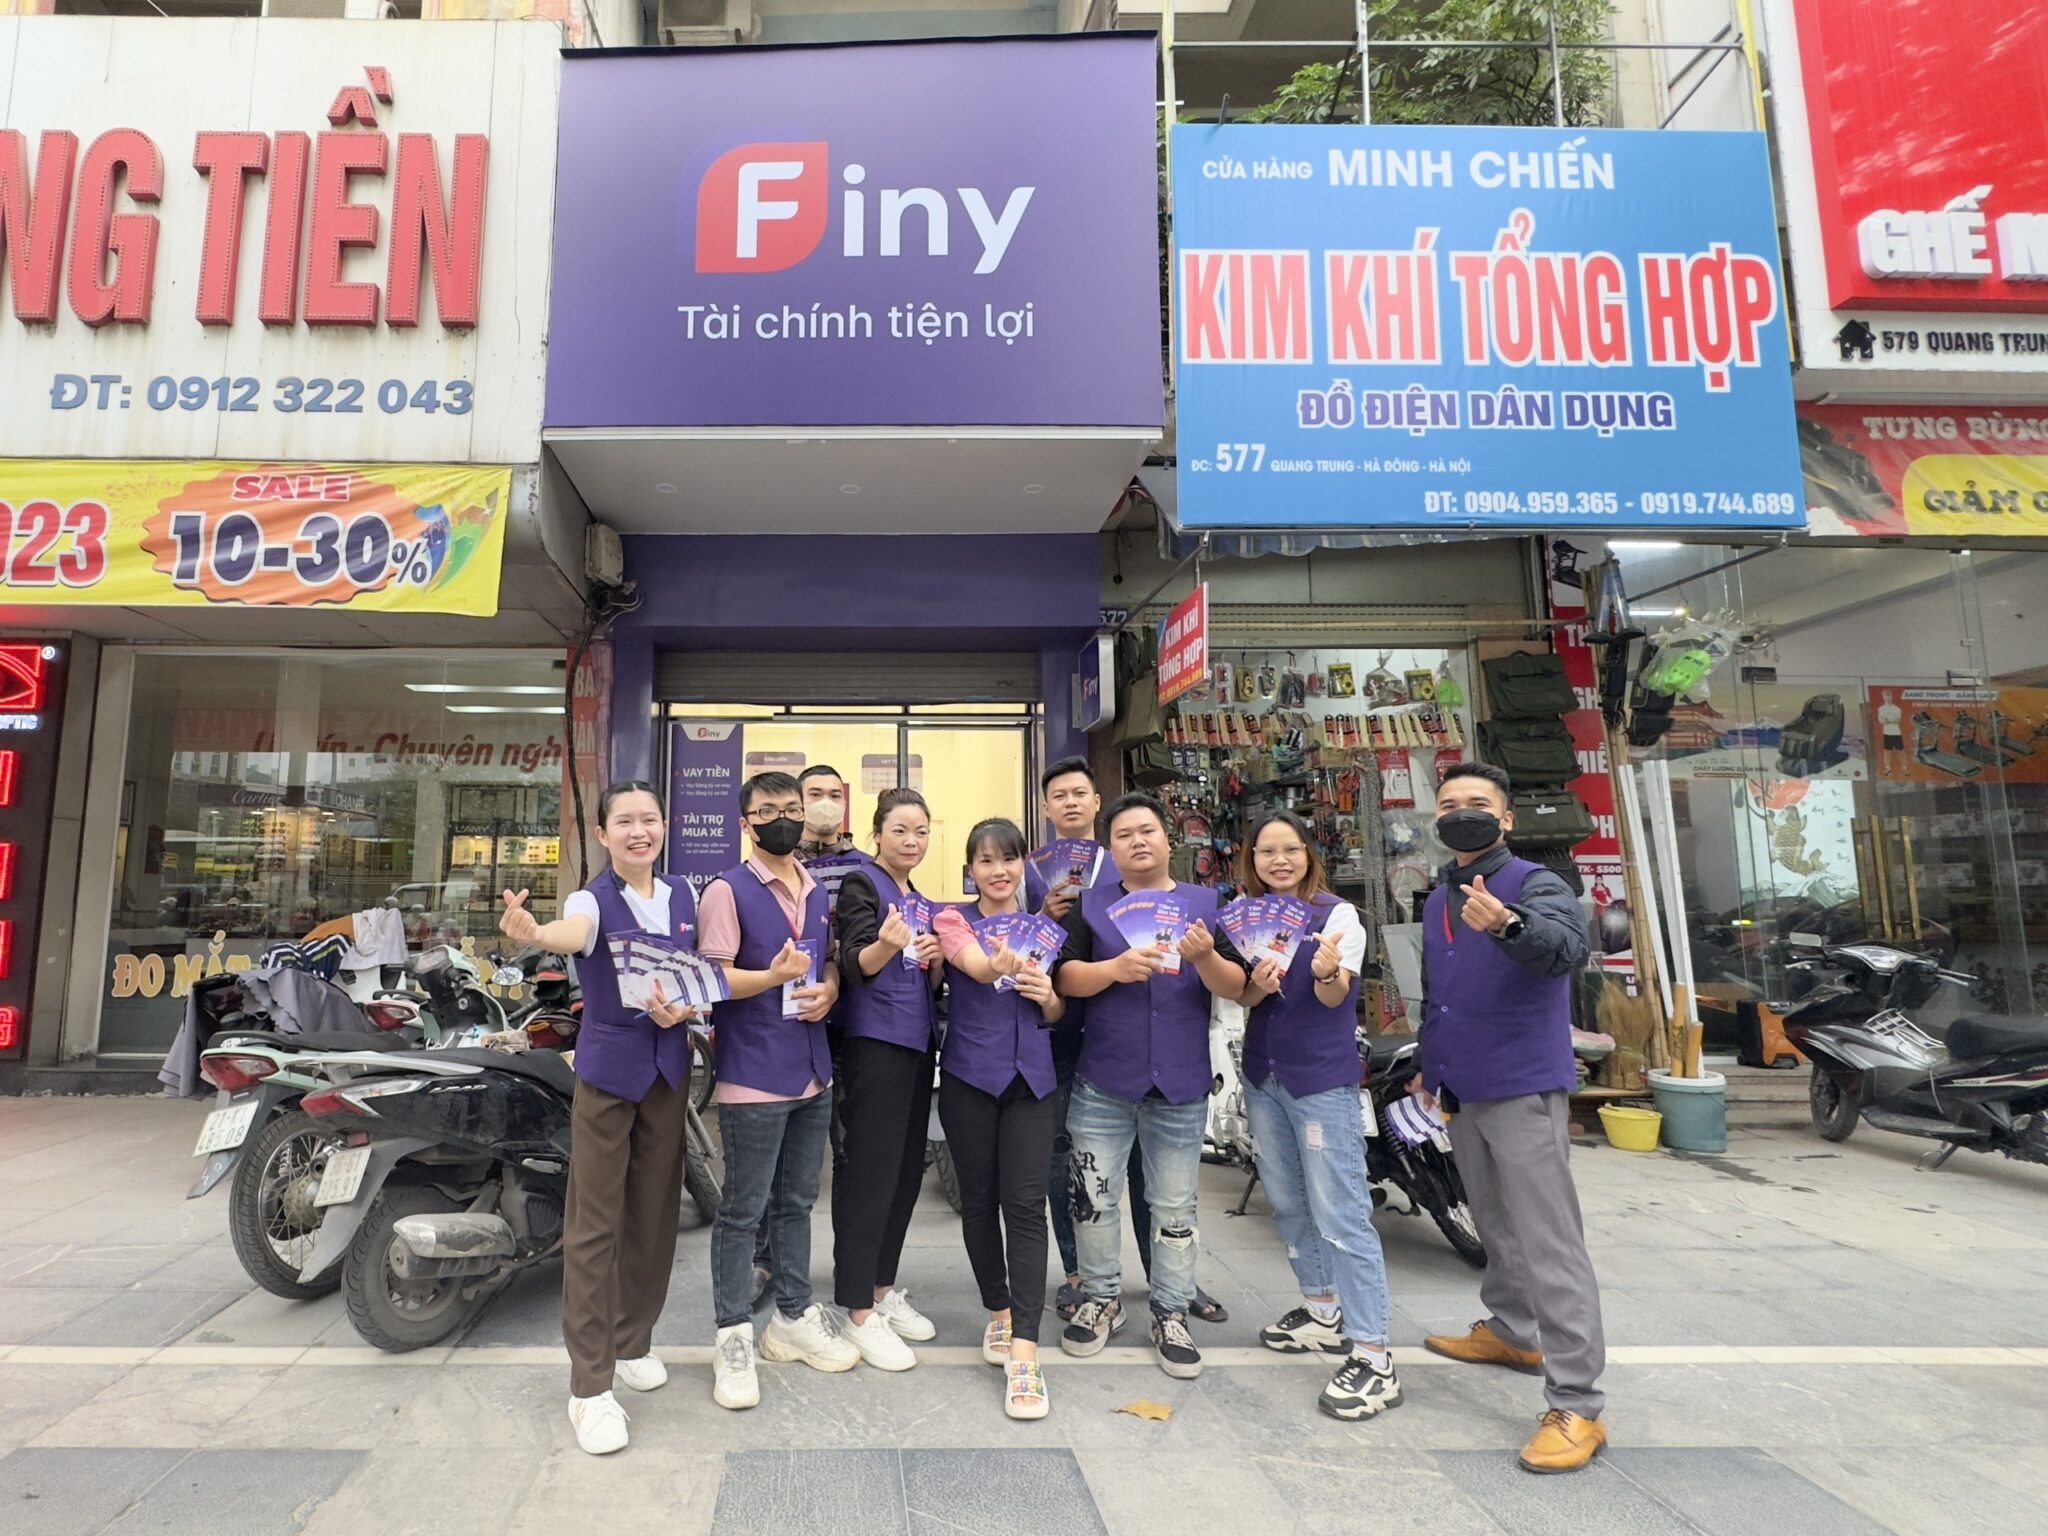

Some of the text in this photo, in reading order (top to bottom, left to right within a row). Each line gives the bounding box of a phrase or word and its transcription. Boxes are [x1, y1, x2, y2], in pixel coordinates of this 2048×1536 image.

[1202, 135, 1615, 189] CỬA HÀNG MINH CHIẾN
[193, 65, 489, 328] TIỀN
[736, 161, 1036, 275] Finy
[1857, 184, 1993, 280] GHẾ
[1180, 208, 1777, 392] KIM KHÍ TỔNG HỢP
[678, 302, 1034, 346] Tài chính tiện lợi
[1882, 331, 1919, 350] 579
[1928, 332, 1994, 353] QUANG
[50, 374, 474, 415] ĐT: 0912 322 043
[1297, 379, 1677, 437] ĐỒ ĐIỆN DÂN DỤNG
[1191, 459, 1212, 472] ĐC:
[1215, 443, 1266, 472] 577
[1270, 460, 1313, 473] QUANG
[1316, 460, 1354, 473] TRUNG
[1364, 457, 1381, 473] HÀ
[1384, 457, 1420, 473] ĐÔNG
[1429, 457, 1447, 473] HÀ
[1449, 457, 1471, 476] NỘI
[232, 474, 351, 501] SALE
[1424, 491, 1457, 513] ĐT:
[1465, 491, 1618, 514] 0904.959.365
[1641, 492, 1795, 515] 0919.744.689
[1923, 480, 2021, 514] GIẢM
[169, 511, 429, 586] 10-30%
[1165, 600, 1198, 650] KIM KHÍ
[1183, 637, 1203, 669] HỢP
[683, 764, 730, 777] VAY TIỀN
[682, 827, 724, 837] MUA XE
[683, 812, 725, 826] TÀI TRỢ
[111, 953, 165, 998] ĐO
